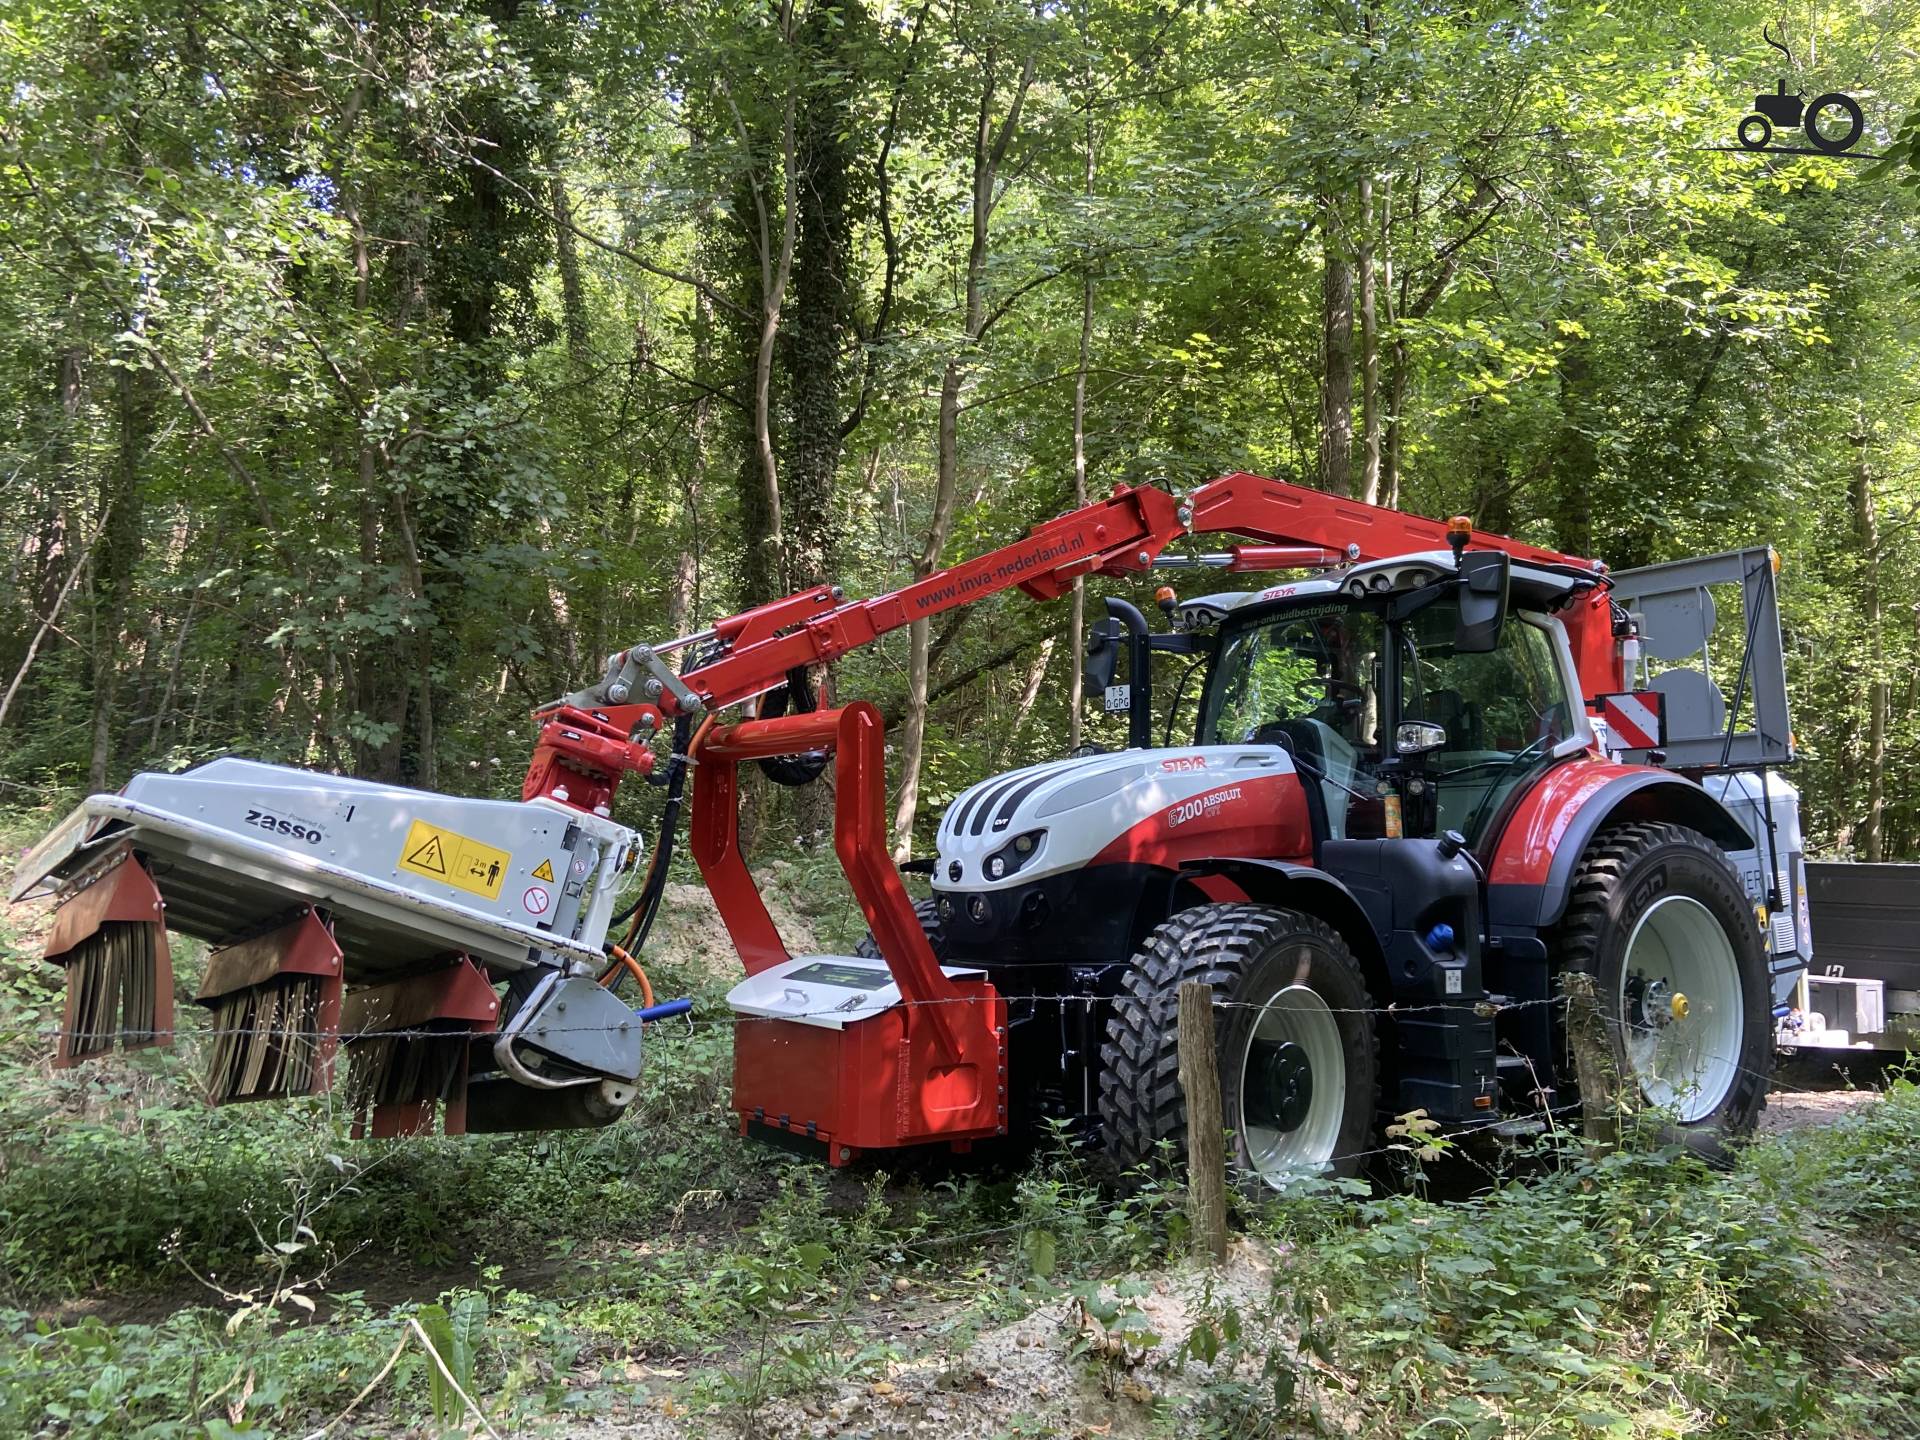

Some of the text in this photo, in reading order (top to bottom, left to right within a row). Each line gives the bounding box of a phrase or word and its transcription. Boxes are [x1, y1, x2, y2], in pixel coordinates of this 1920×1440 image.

[916, 533, 1085, 608] www.inva-nederland.nl
[1263, 587, 1296, 600] STEYR
[1162, 756, 1207, 773] STEYR
[1168, 788, 1242, 828] 6200 ABSOLUT
[1205, 806, 1221, 819] CVT
[245, 809, 322, 845] zasso
